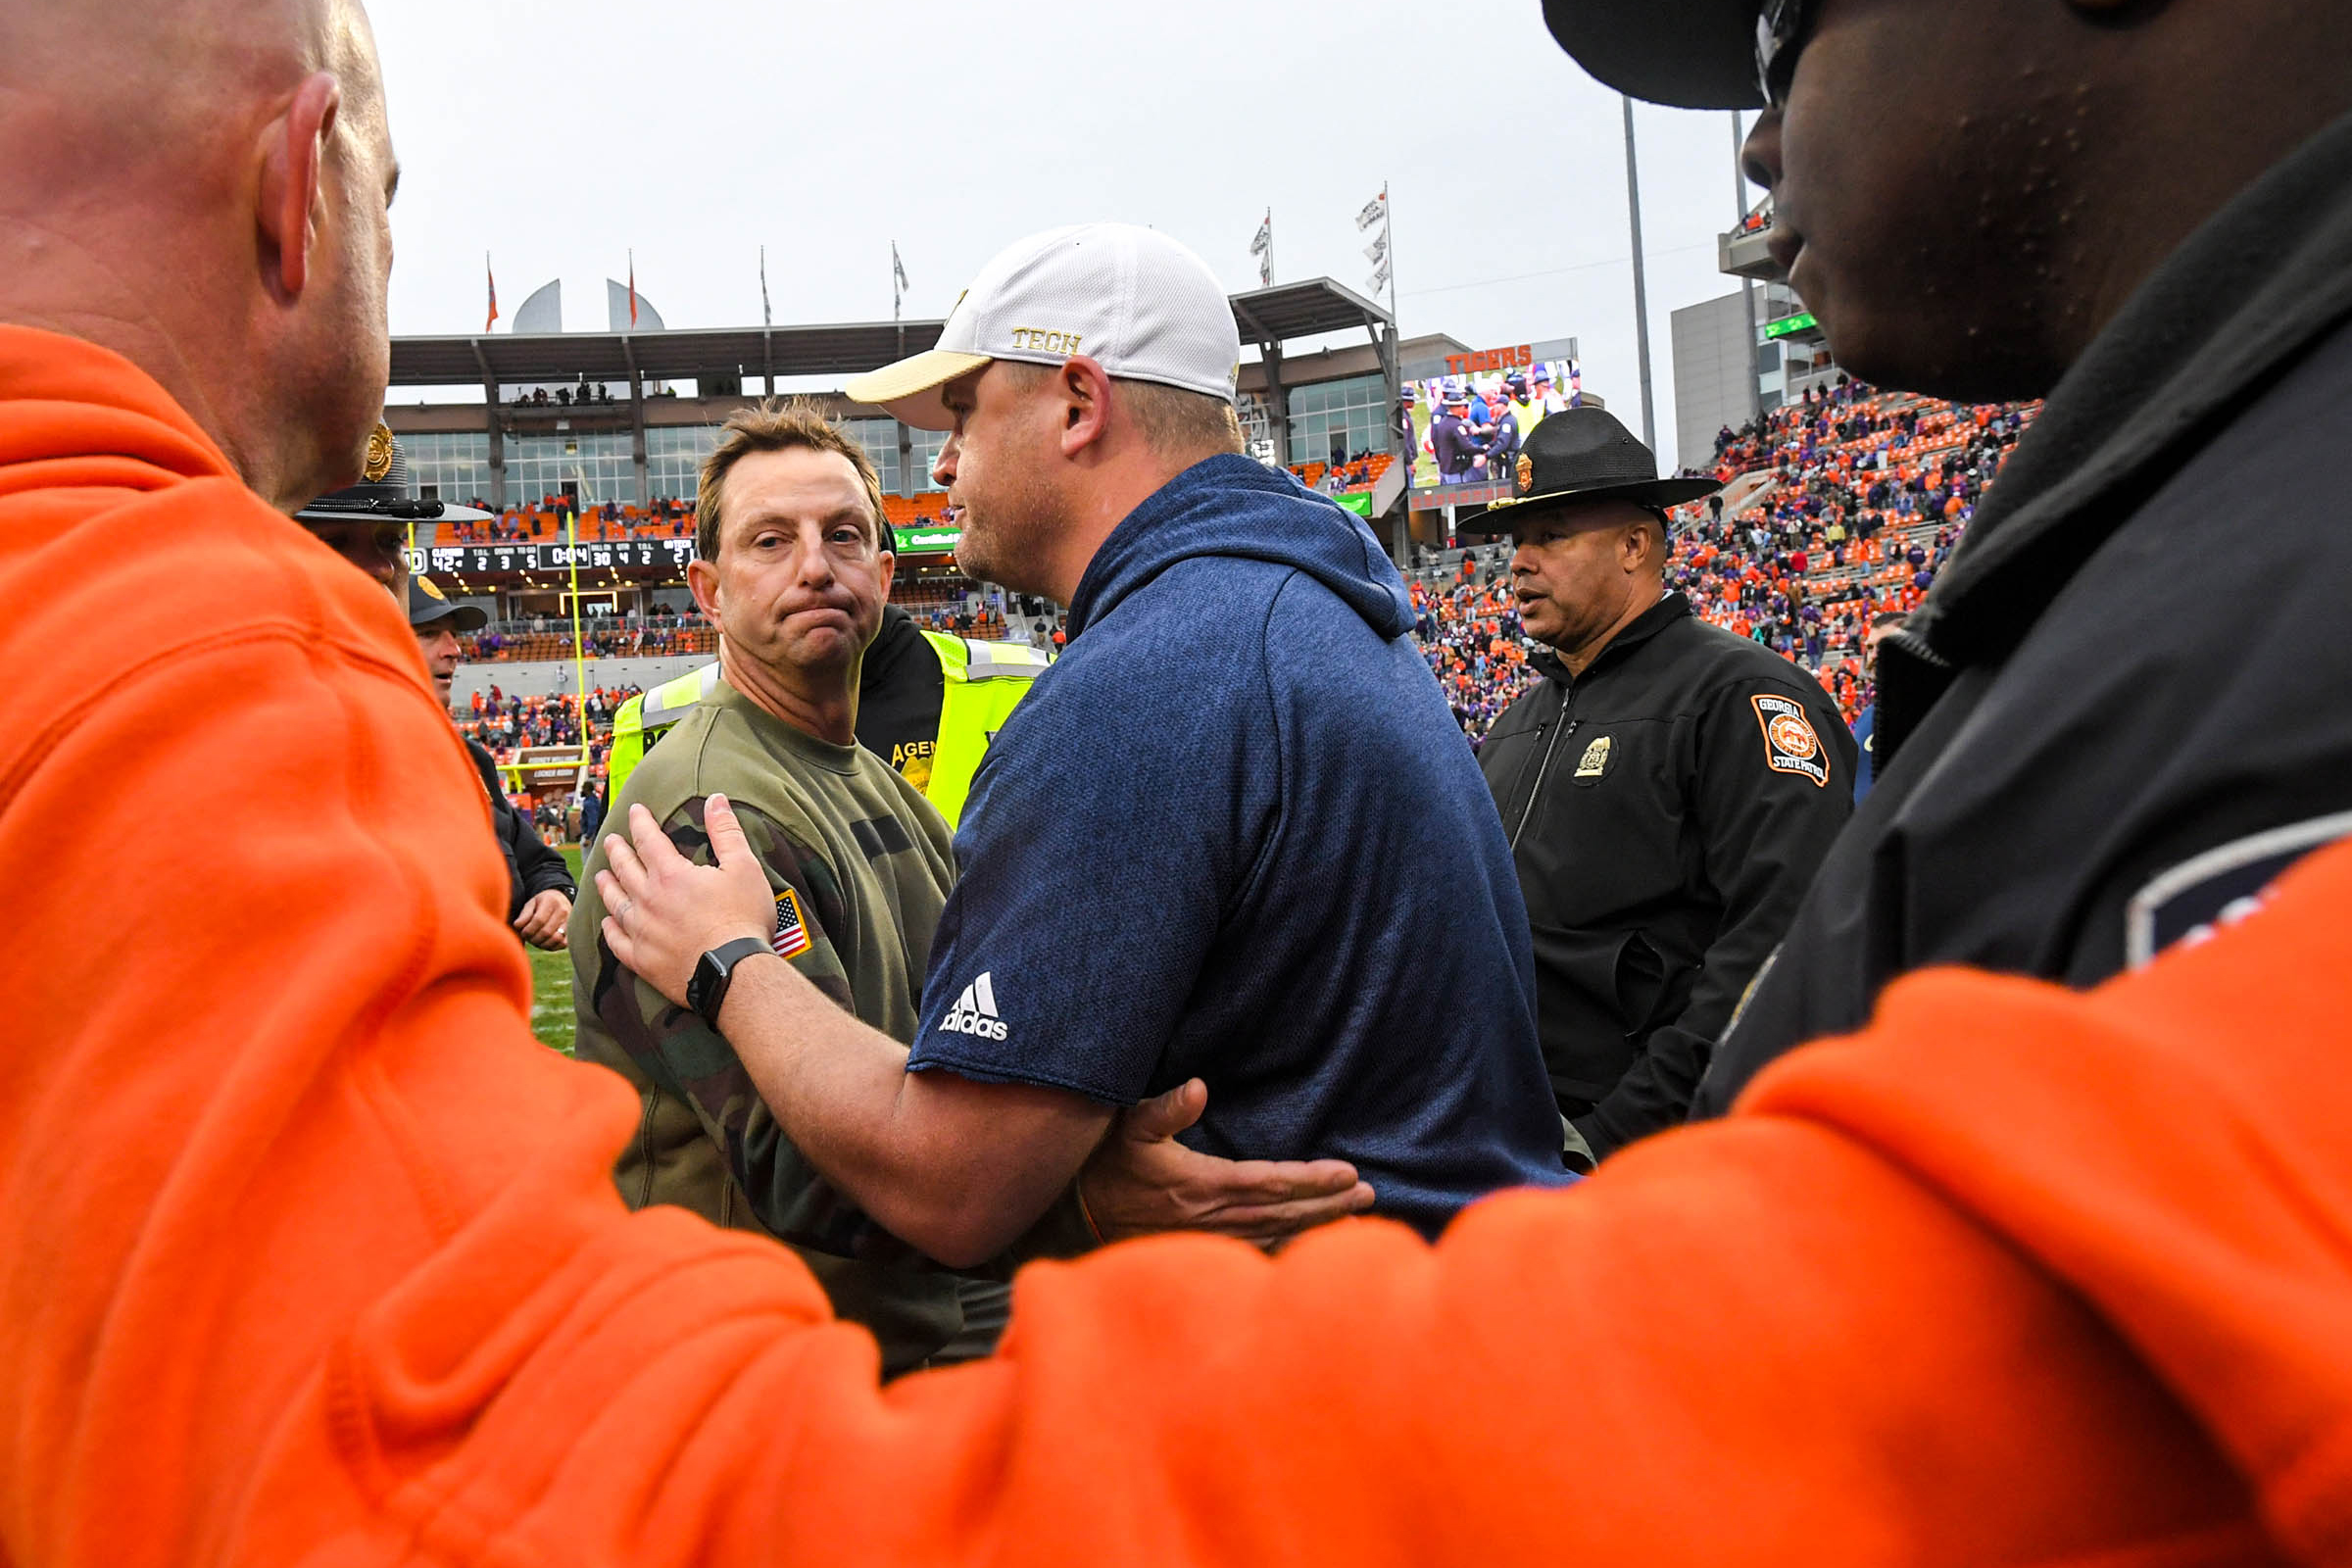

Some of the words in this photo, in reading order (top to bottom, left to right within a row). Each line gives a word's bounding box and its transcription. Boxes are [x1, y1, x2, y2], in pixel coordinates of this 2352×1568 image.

[1011, 326, 1082, 356] TECH
[1445, 344, 1532, 374] TIGERS
[501, 556, 510, 569] 3
[526, 555, 537, 568] 5
[552, 548, 588, 564] 0:04
[594, 552, 611, 566] 30
[618, 552, 628, 564] 4
[642, 551, 651, 564] 2
[432, 557, 454, 572] 42
[477, 557, 487, 571] 2
[1758, 698, 1800, 717] GEORGIA
[1773, 756, 1801, 769] STATE
[938, 1007, 1008, 1041] adidas
